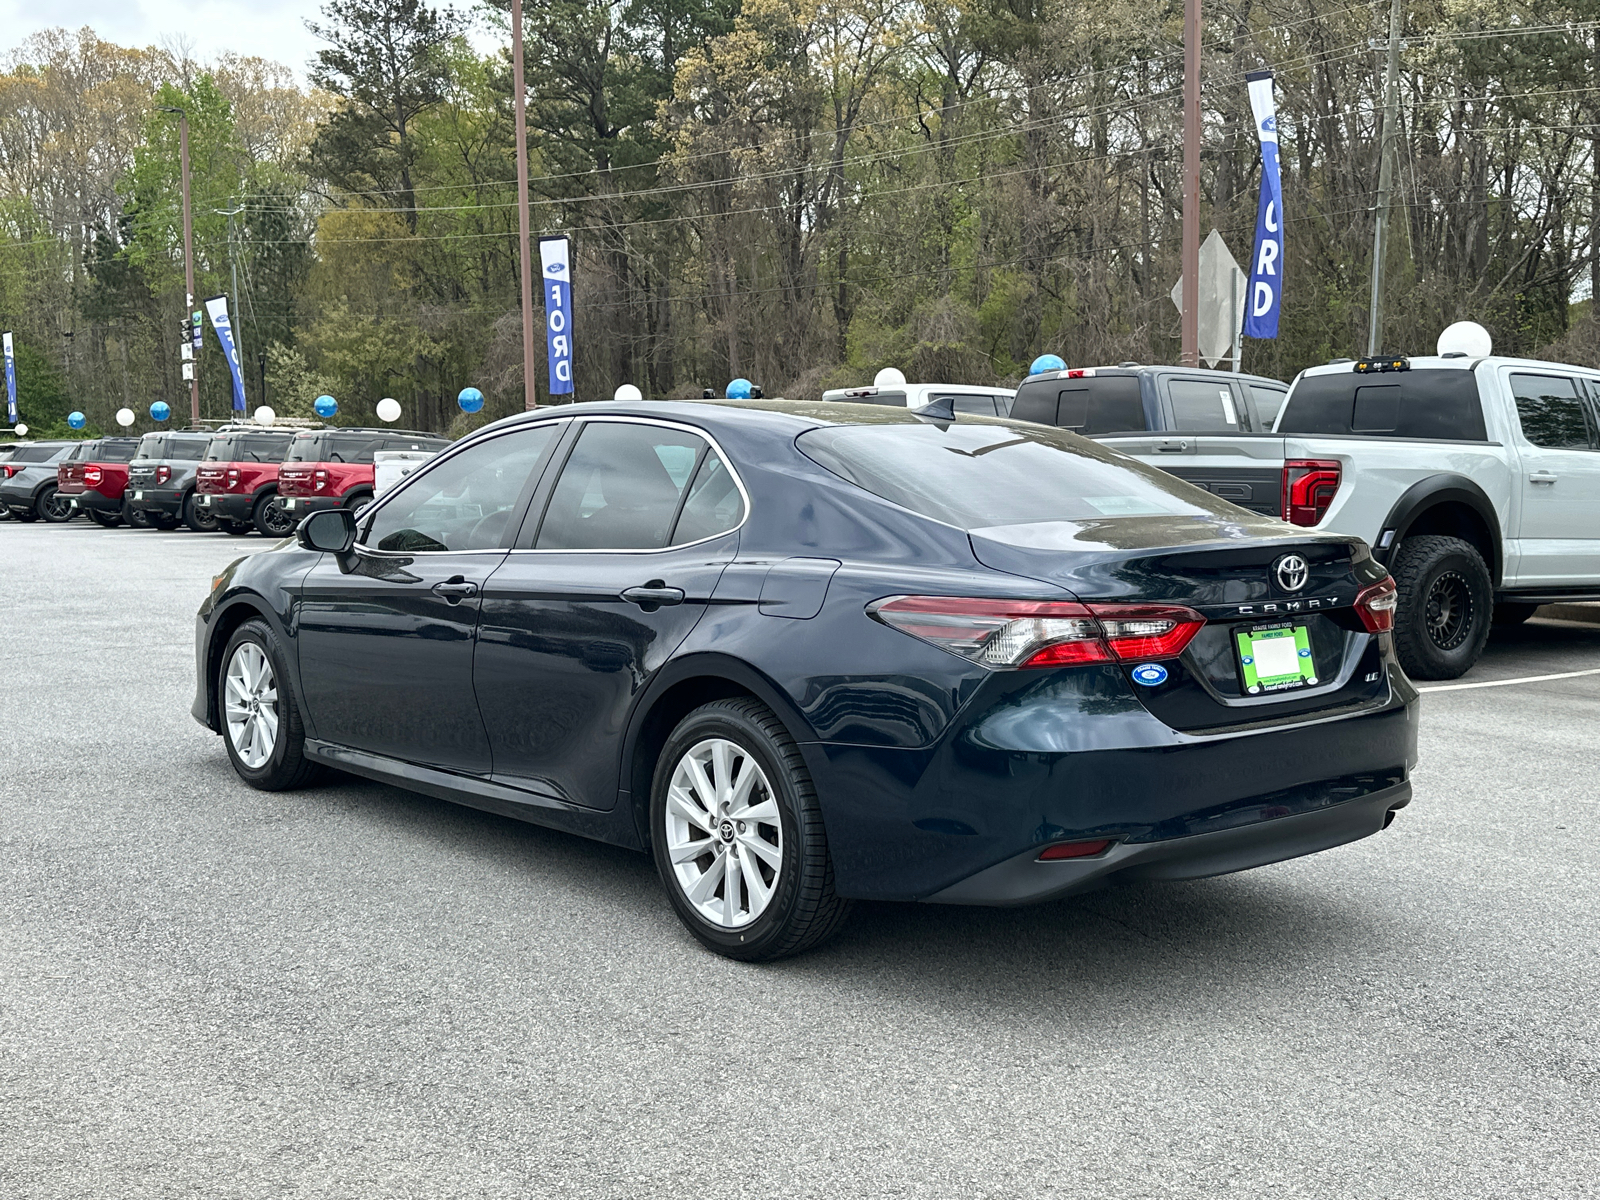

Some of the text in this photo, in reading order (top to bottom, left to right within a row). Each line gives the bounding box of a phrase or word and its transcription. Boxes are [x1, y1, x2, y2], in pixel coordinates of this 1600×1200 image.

[1238, 597, 1339, 614] CAMRY
[1364, 671, 1379, 682] LE
[780, 827, 797, 911] FALKEN
